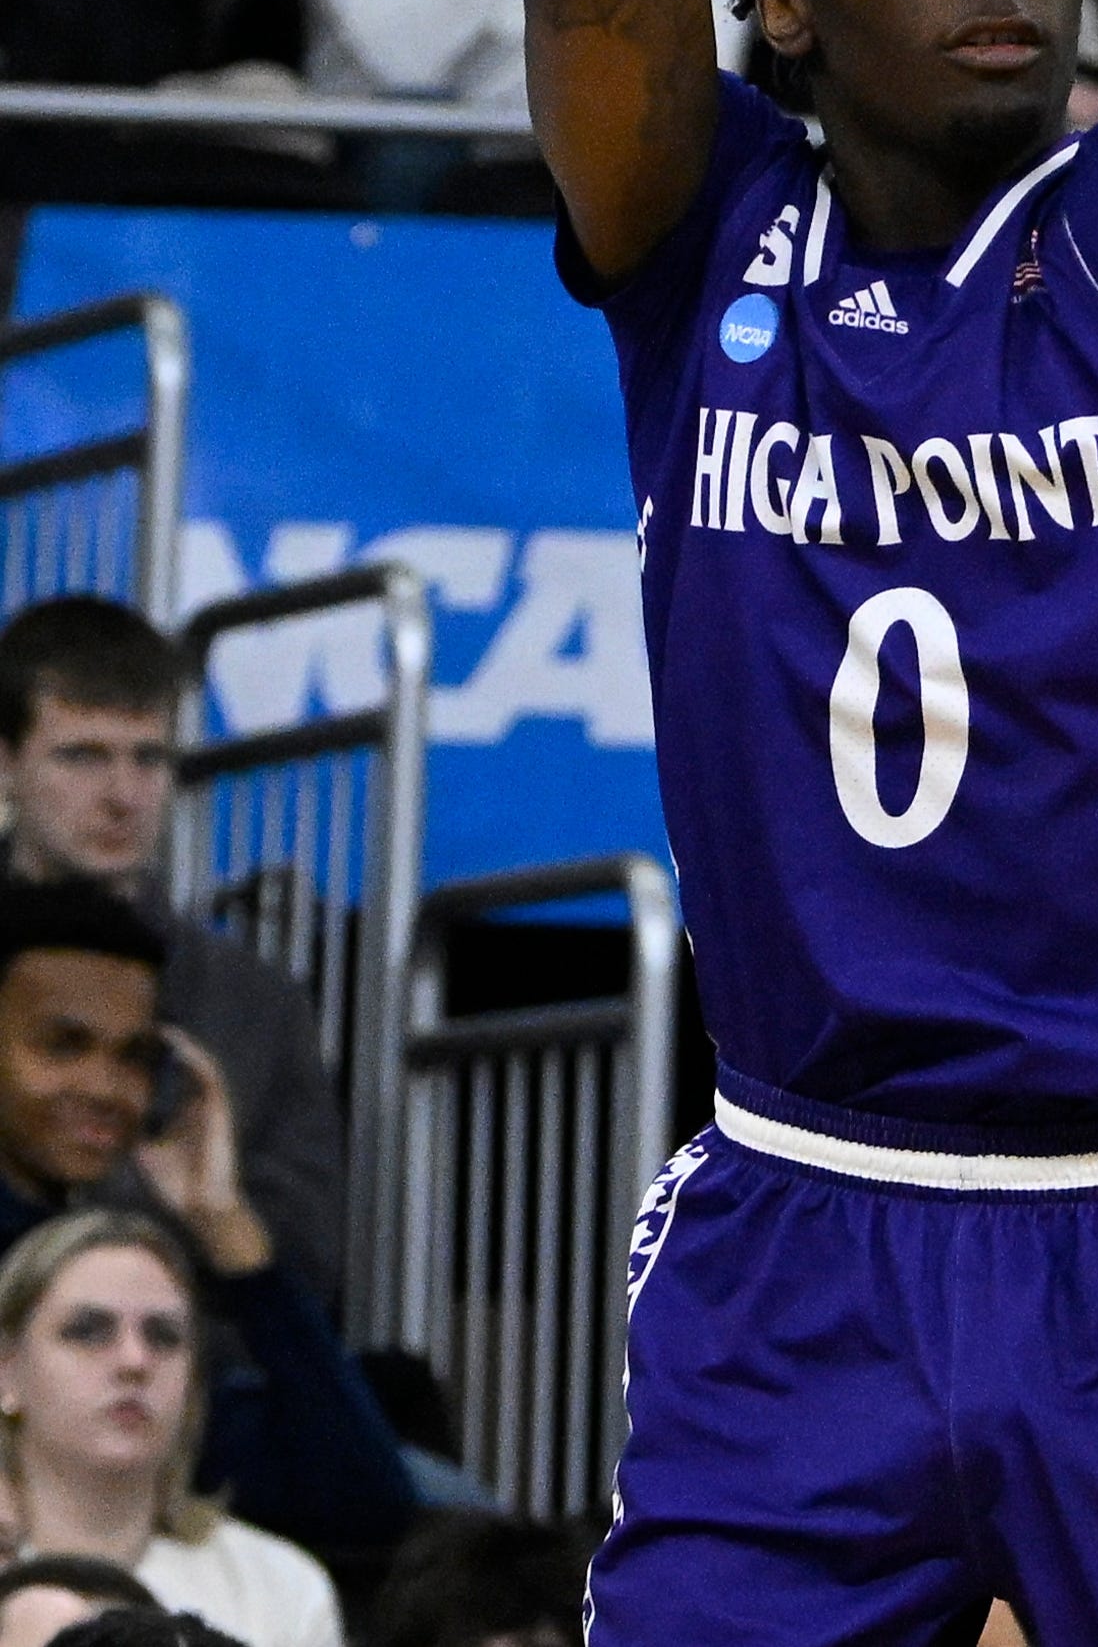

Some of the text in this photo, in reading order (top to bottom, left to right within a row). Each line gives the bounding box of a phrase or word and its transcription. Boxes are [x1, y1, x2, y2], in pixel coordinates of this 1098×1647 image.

[828, 308, 909, 334] adidas
[724, 323, 772, 347] NCAA
[829, 587, 969, 849] 0
